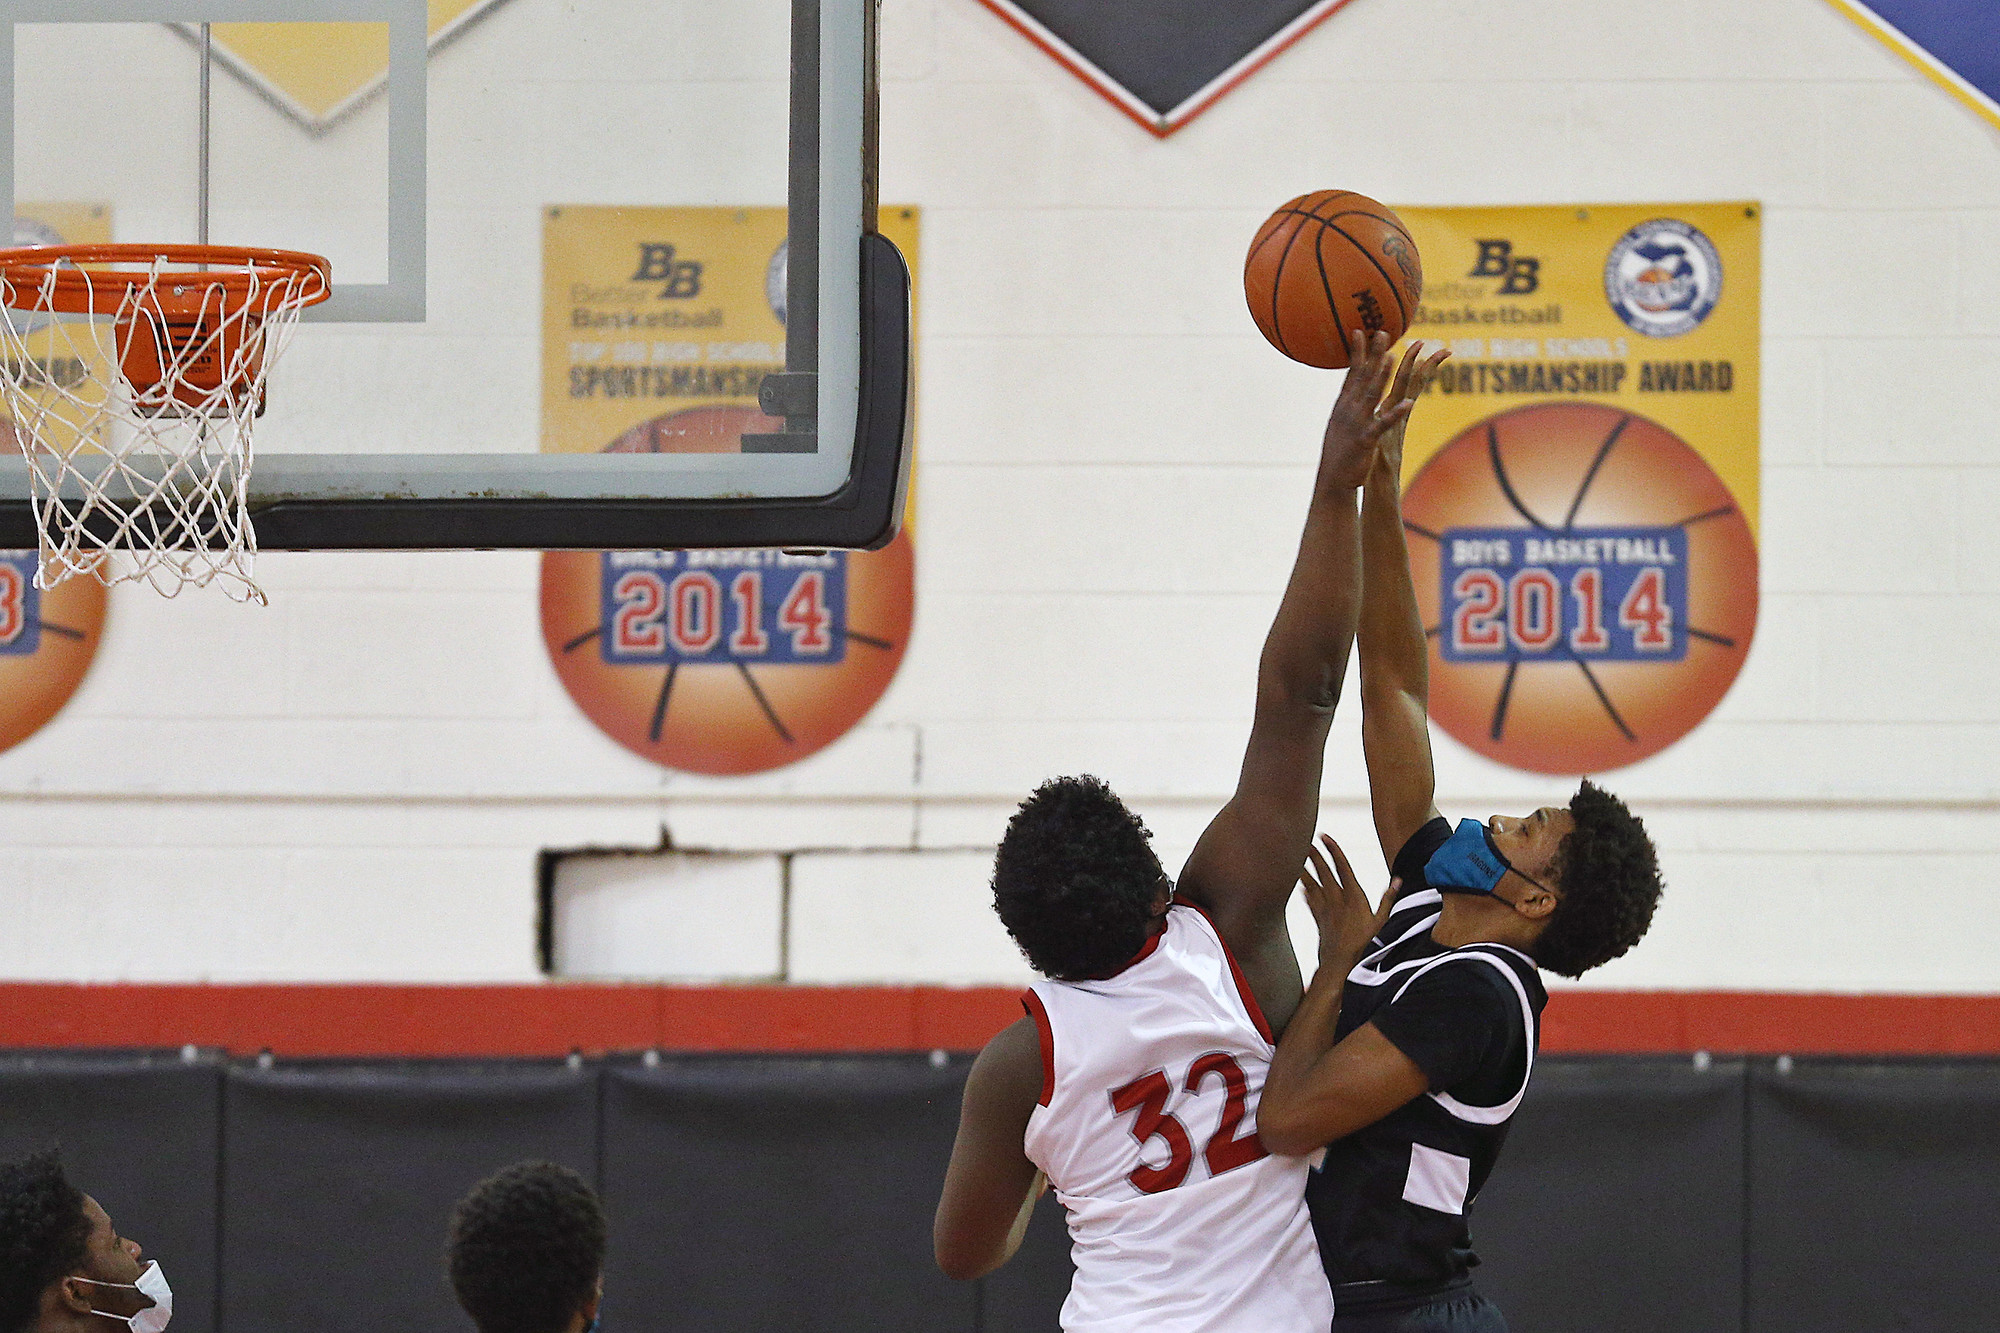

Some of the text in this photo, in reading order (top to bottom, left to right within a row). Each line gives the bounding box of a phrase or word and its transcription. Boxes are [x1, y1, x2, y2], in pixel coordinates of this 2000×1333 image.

[1421, 283, 1487, 301] etter
[570, 308, 723, 329] Basketball
[569, 365, 786, 398] SPORTSMANSH
[1418, 361, 1734, 394] PORTSMANSHIP AWARD
[1452, 537, 1676, 566] BOYS BASKETBALL
[612, 570, 833, 655] 2014
[1452, 566, 1674, 652] 2014
[1107, 1050, 1272, 1196] 32
